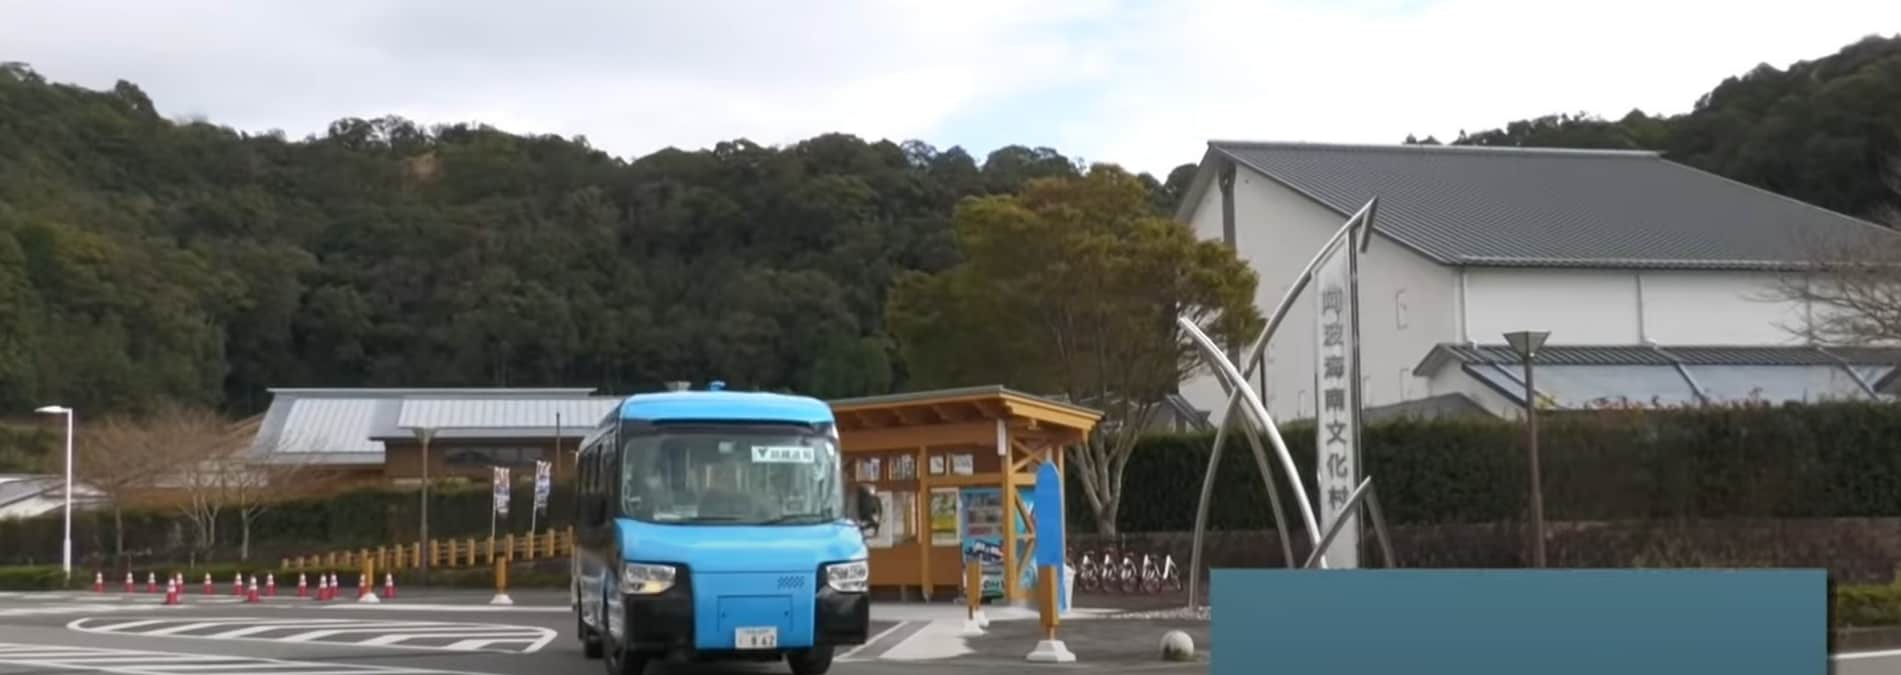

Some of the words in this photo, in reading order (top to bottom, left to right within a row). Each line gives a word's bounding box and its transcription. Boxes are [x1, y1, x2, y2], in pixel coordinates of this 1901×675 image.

[1322, 287, 1349, 510] 阿波海南文化村
